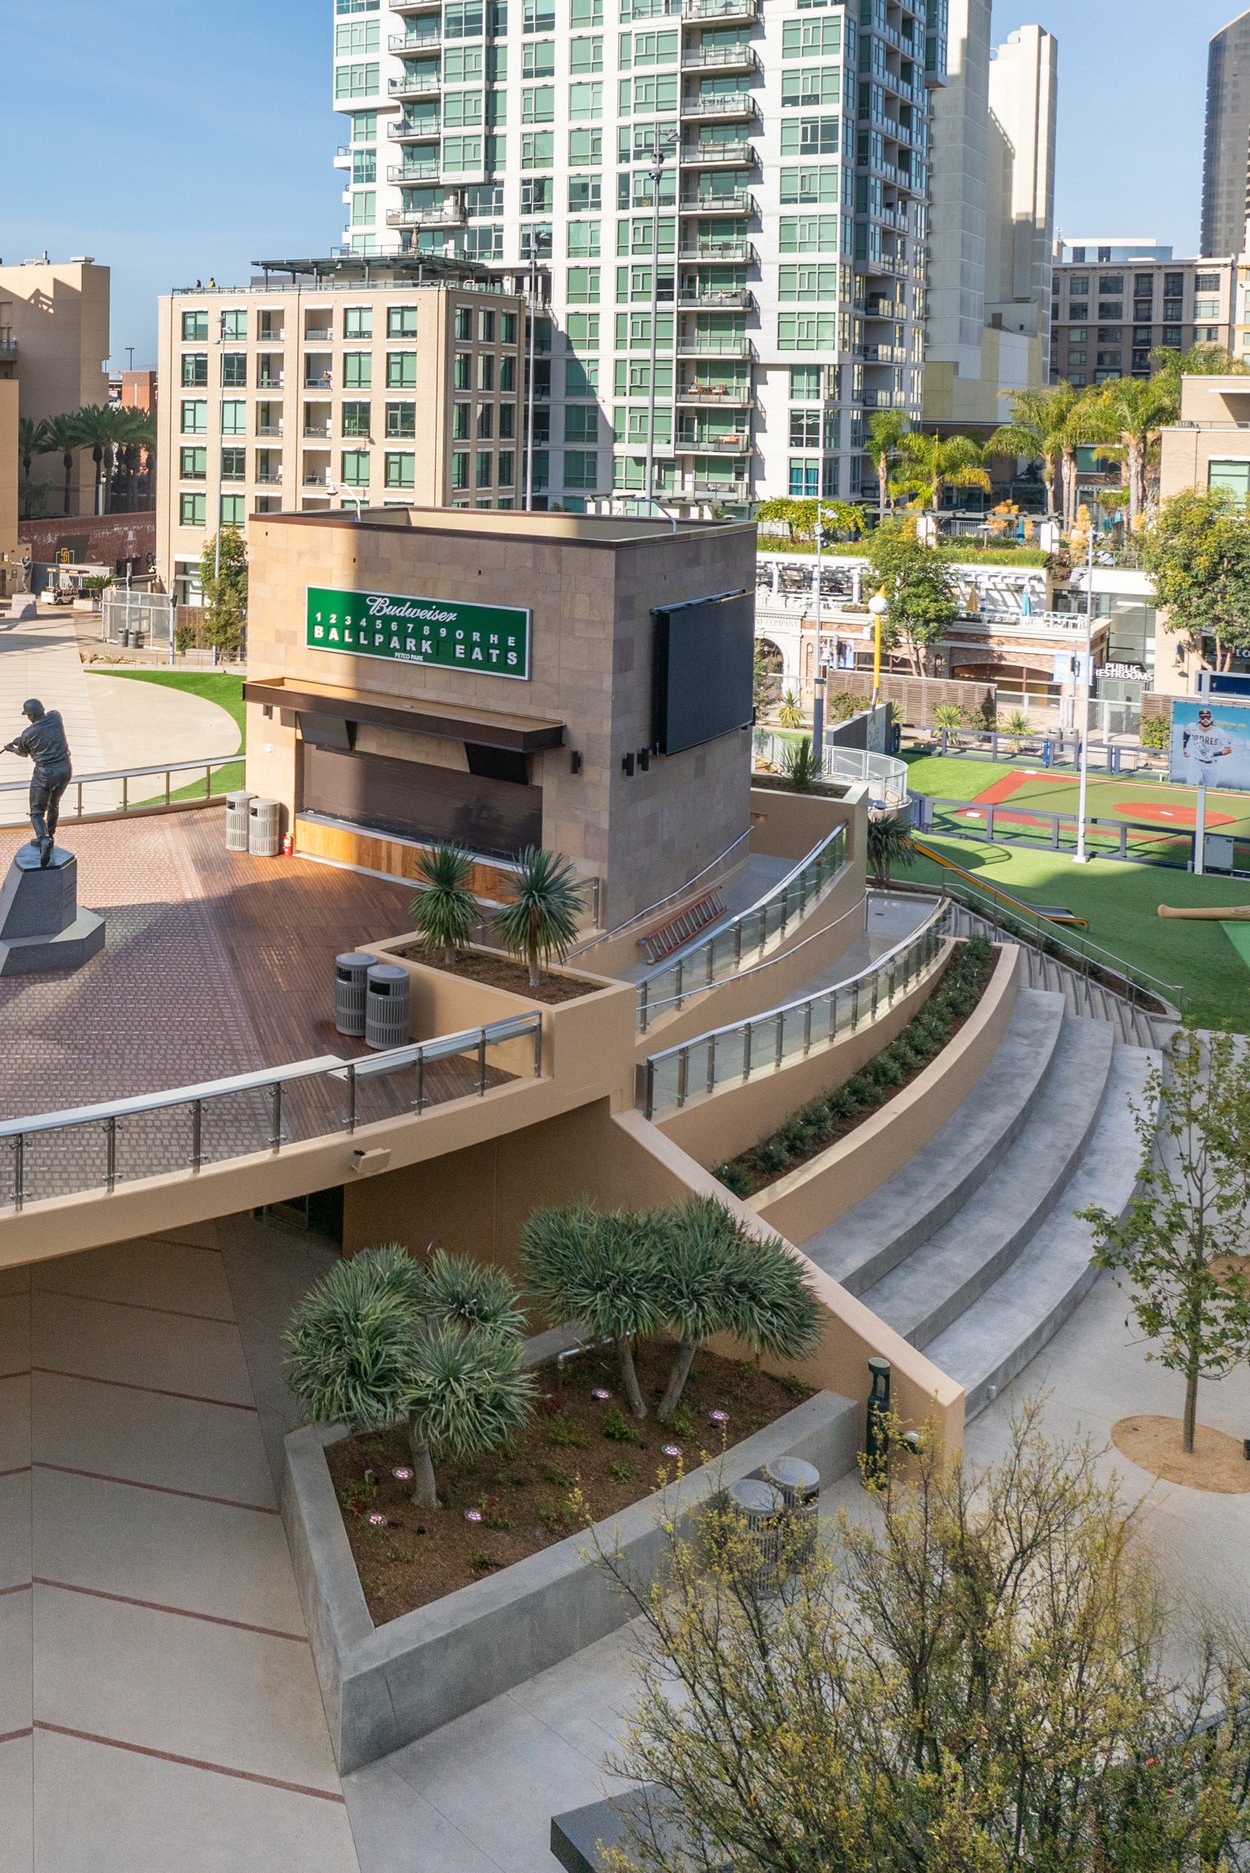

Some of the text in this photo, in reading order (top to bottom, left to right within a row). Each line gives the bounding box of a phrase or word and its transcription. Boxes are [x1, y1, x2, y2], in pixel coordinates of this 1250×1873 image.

[366, 596, 457, 622] Budweiser
[315, 612, 321, 621] 1
[330, 614, 336, 624] 2
[360, 618, 366, 627] 4
[376, 620, 382, 628] 5
[391, 622, 397, 631] 6
[407, 624, 413, 632] 7
[424, 626, 430, 635] 8
[440, 628, 446, 637] 9
[473, 633, 480, 642] R
[490, 635, 498, 644] H
[508, 637, 515, 646] E
[314, 625, 518, 665] BALLPARK EATS
[395, 652, 424, 662] PETCO PARK
[1105, 663, 1141, 673] PUBLIC
